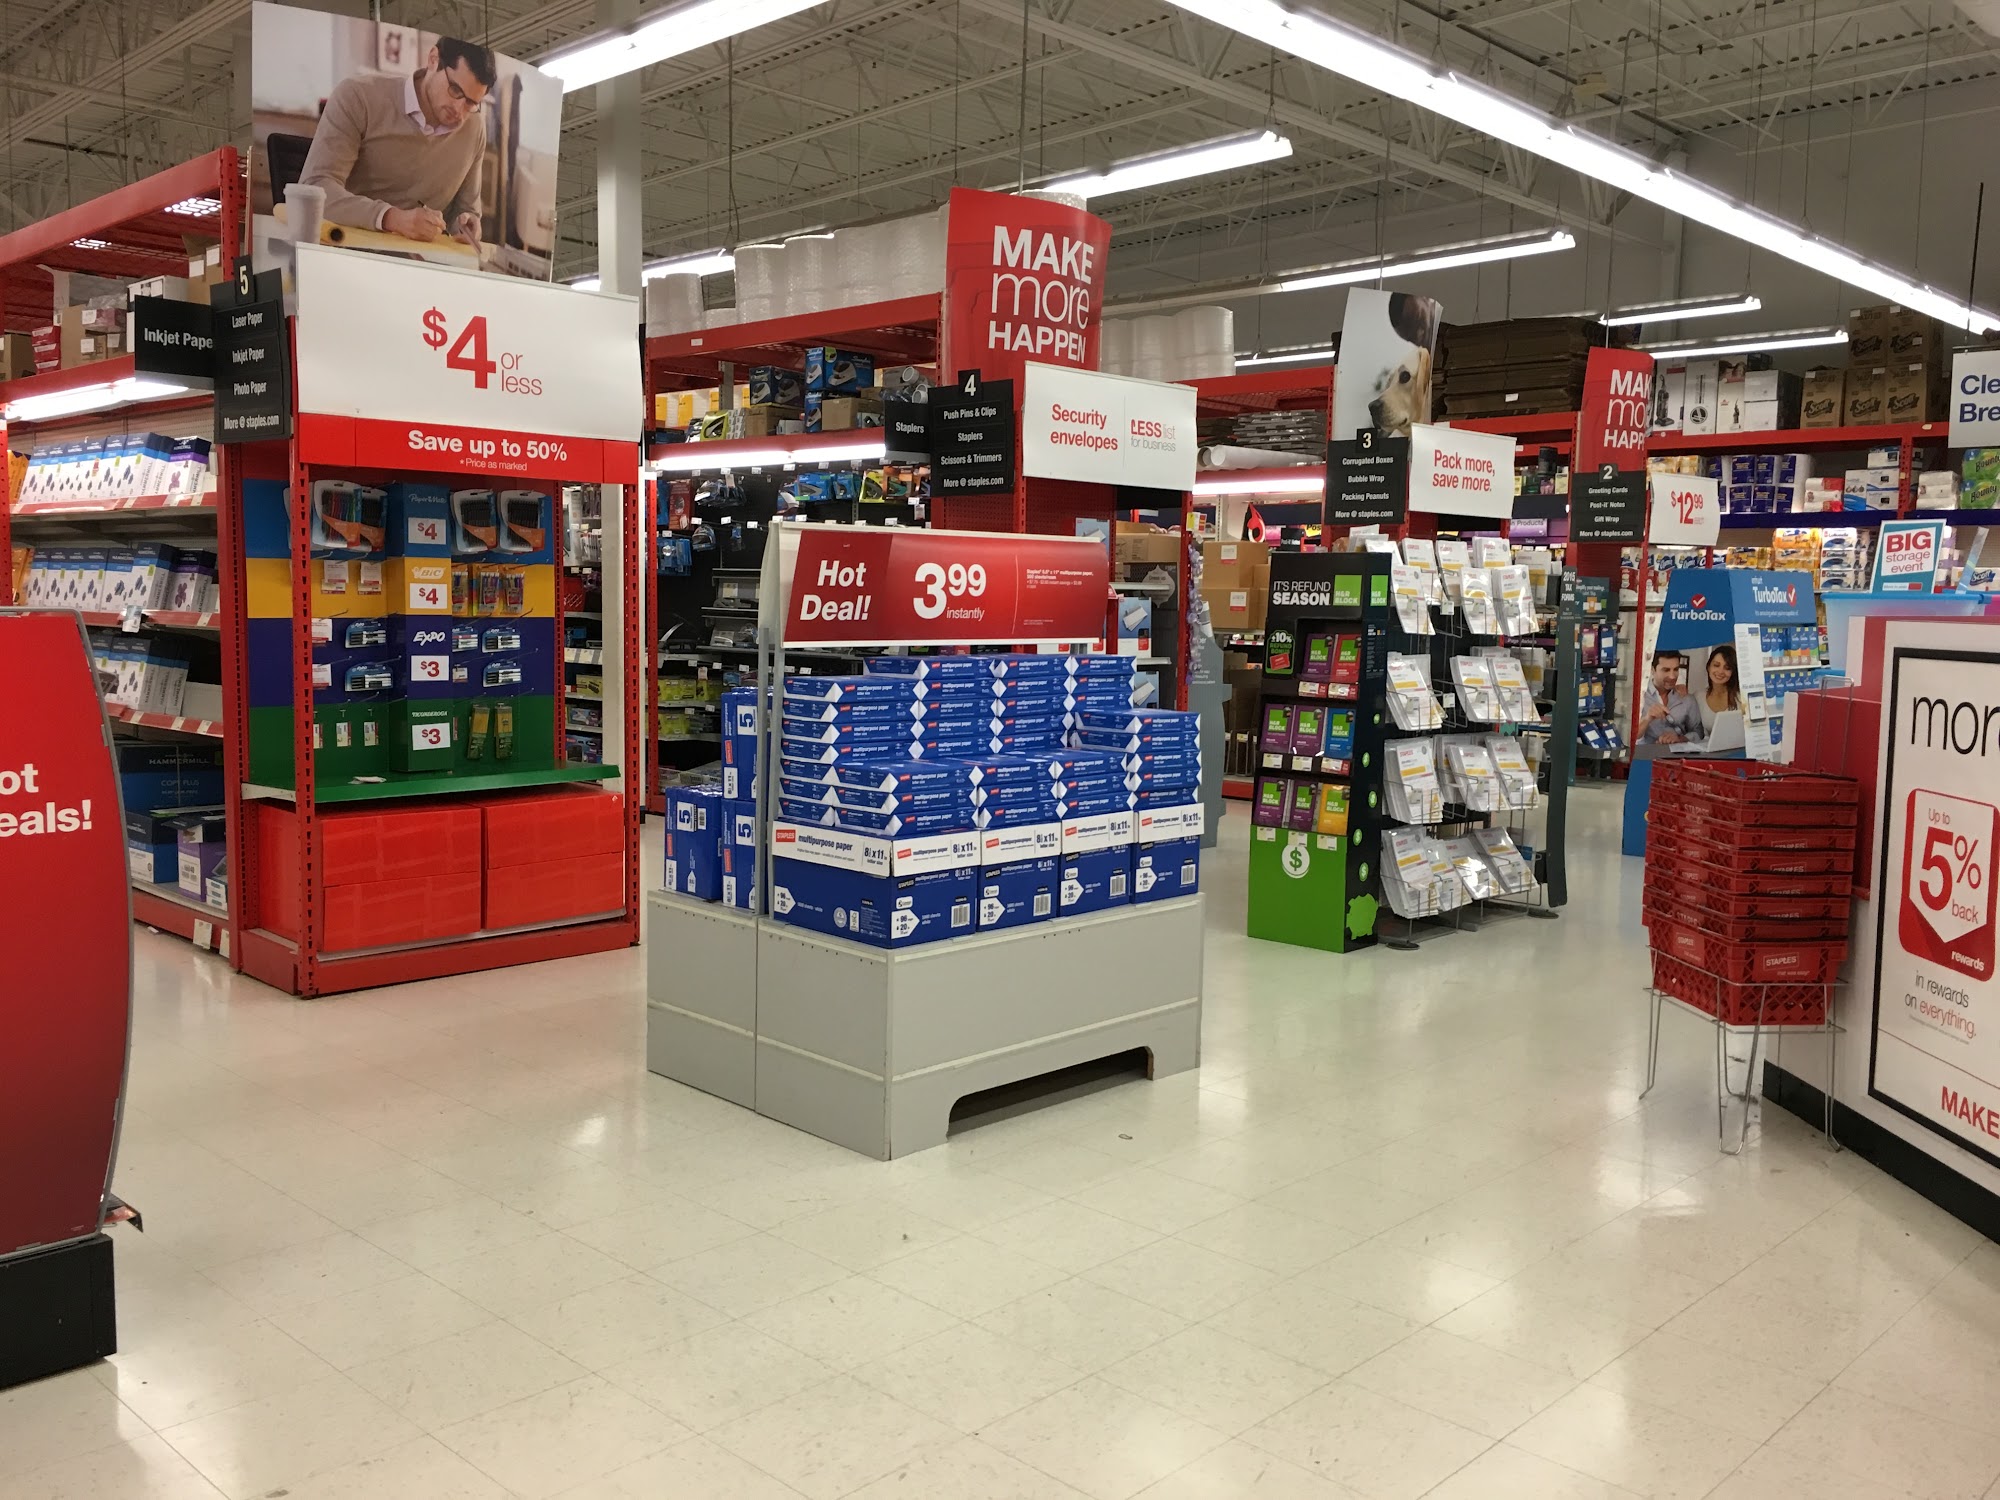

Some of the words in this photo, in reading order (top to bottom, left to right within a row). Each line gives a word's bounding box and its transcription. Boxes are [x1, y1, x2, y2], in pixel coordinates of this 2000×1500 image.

[992, 225, 1094, 285] MAKE
[239, 265, 249, 295] 5
[991, 272, 1089, 329] more
[232, 315, 247, 328] Laser
[248, 312, 263, 326] Paper
[144, 328, 180, 346] Inkjet
[183, 332, 213, 350] Pape
[422, 306, 496, 389] $4
[988, 320, 1086, 364] HAPPEN
[232, 350, 248, 365] Inkjet
[249, 348, 265, 362] Paper
[500, 352, 523, 370] or
[234, 382, 250, 396] Photo
[251, 381, 267, 395] Paper
[501, 370, 542, 396] less
[964, 374, 977, 396] 4
[1961, 374, 2000, 396] Cle
[944, 410, 959, 420] Push
[960, 409, 973, 418] Pins
[974, 408, 980, 416] &
[981, 406, 997, 417] Clips
[1052, 403, 1107, 430] Security
[1959, 403, 2000, 423] Bre
[224, 416, 238, 430] More
[239, 416, 245, 429] @
[246, 414, 279, 430] staples.com
[895, 421, 924, 434] Staplers
[1131, 419, 1162, 438] LESS
[1163, 423, 1176, 440] list
[408, 429, 463, 452] Save
[470, 433, 496, 459] up
[501, 437, 521, 457] to
[526, 441, 568, 461] 50%
[957, 431, 983, 443] Staplers
[1050, 430, 1118, 452] envelopes
[1130, 436, 1141, 447] for
[1142, 437, 1176, 452] business
[1363, 432, 1372, 448] 3
[465, 457, 485, 469] Price
[487, 461, 496, 469] as
[498, 460, 527, 471] marked
[941, 455, 965, 465] Scissors
[967, 455, 972, 463] &
[973, 453, 1002, 463] Trimmers
[1342, 457, 1374, 466] Corrugated
[1376, 456, 1394, 464] Boxes
[1434, 449, 1462, 470] Pack
[1465, 457, 1496, 477] more,
[1348, 475, 1368, 483] Bubble
[1369, 475, 1385, 483] Wrap
[1603, 465, 1612, 479] 2
[944, 478, 959, 488] More
[960, 478, 966, 487] @
[967, 476, 1004, 488] staples.com
[1432, 472, 1458, 489] save
[1462, 479, 1492, 493] more.
[1341, 493, 1364, 502] Packing
[1365, 492, 1389, 500] Peanuts
[1588, 487, 1611, 495] Greeting
[1971, 485, 1997, 503] Bounty
[1335, 510, 1350, 518] More
[1351, 510, 1357, 518] @
[1358, 510, 1393, 518] staples.com
[417, 523, 438, 540] $4
[1886, 531, 1932, 551] BIG
[1886, 550, 1931, 564] storage
[817, 559, 866, 588] Hot
[1891, 561, 1923, 573] event
[1563, 571, 1575, 581] 2015
[1273, 581, 1290, 591] IT'S
[1292, 581, 1331, 592] REFUND
[1753, 586, 1788, 604] TurboTax
[418, 588, 439, 605] $4
[1272, 592, 1331, 606] SEASON
[800, 594, 872, 622] Deal!
[946, 606, 985, 622] instantly
[1670, 609, 1726, 621] TurboTax
[413, 631, 446, 646] EXPO
[420, 661, 440, 678] $3
[739, 712, 754, 728] 5
[1911, 696, 2000, 757] mor
[422, 728, 441, 744] $3
[0, 799, 92, 838] eals!
[678, 809, 691, 824] 5
[1928, 807, 1941, 825] Up
[1942, 811, 1950, 825] to
[738, 823, 751, 838] 5
[798, 835, 834, 848] multipurpose
[835, 840, 853, 851] paper
[877, 849, 884, 860] 11
[1919, 825, 1982, 911] 5%
[1952, 899, 1978, 924] back
[1765, 956, 1797, 966] STAPLES
[1951, 950, 1985, 972] rewards
[1915, 970, 1924, 989] in
[1927, 979, 1969, 1008] rewards
[1904, 992, 1917, 1010] on
[1919, 999, 1977, 1039] everything.
[1941, 1085, 2000, 1140] MAKE
